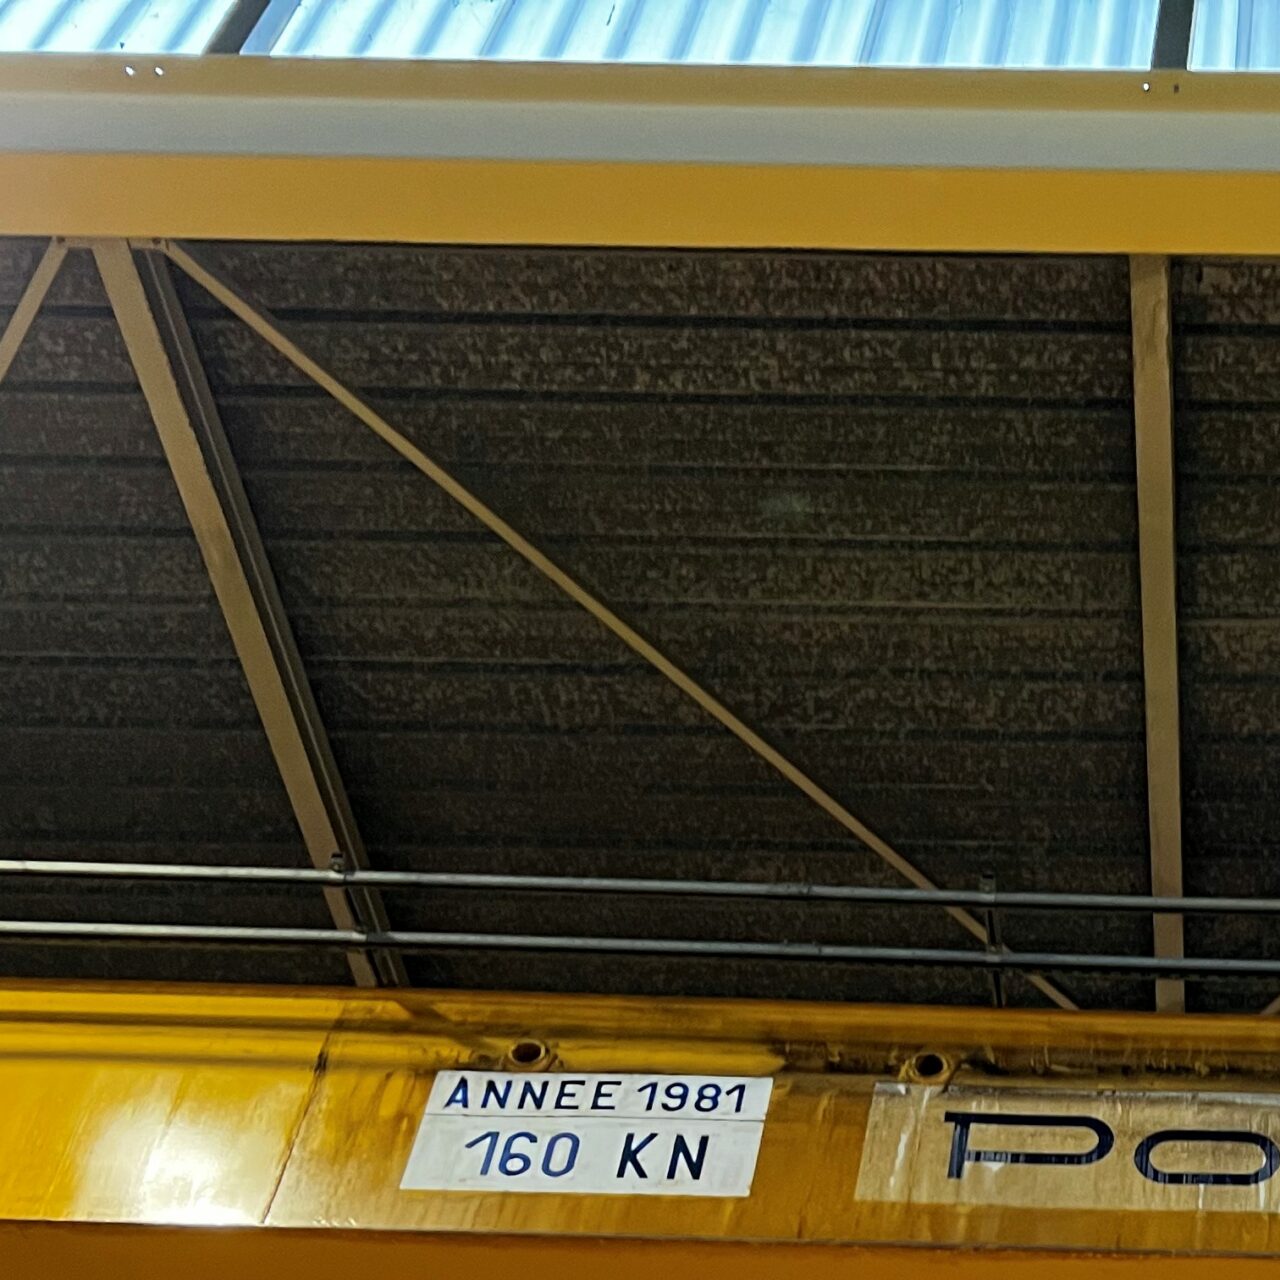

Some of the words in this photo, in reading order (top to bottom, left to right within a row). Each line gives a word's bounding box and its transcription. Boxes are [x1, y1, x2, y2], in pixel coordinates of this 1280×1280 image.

[442, 1076, 623, 1111] ANNEE
[636, 1081, 747, 1114] 1981
[464, 1130, 581, 1178] 160
[615, 1132, 710, 1181] KN
